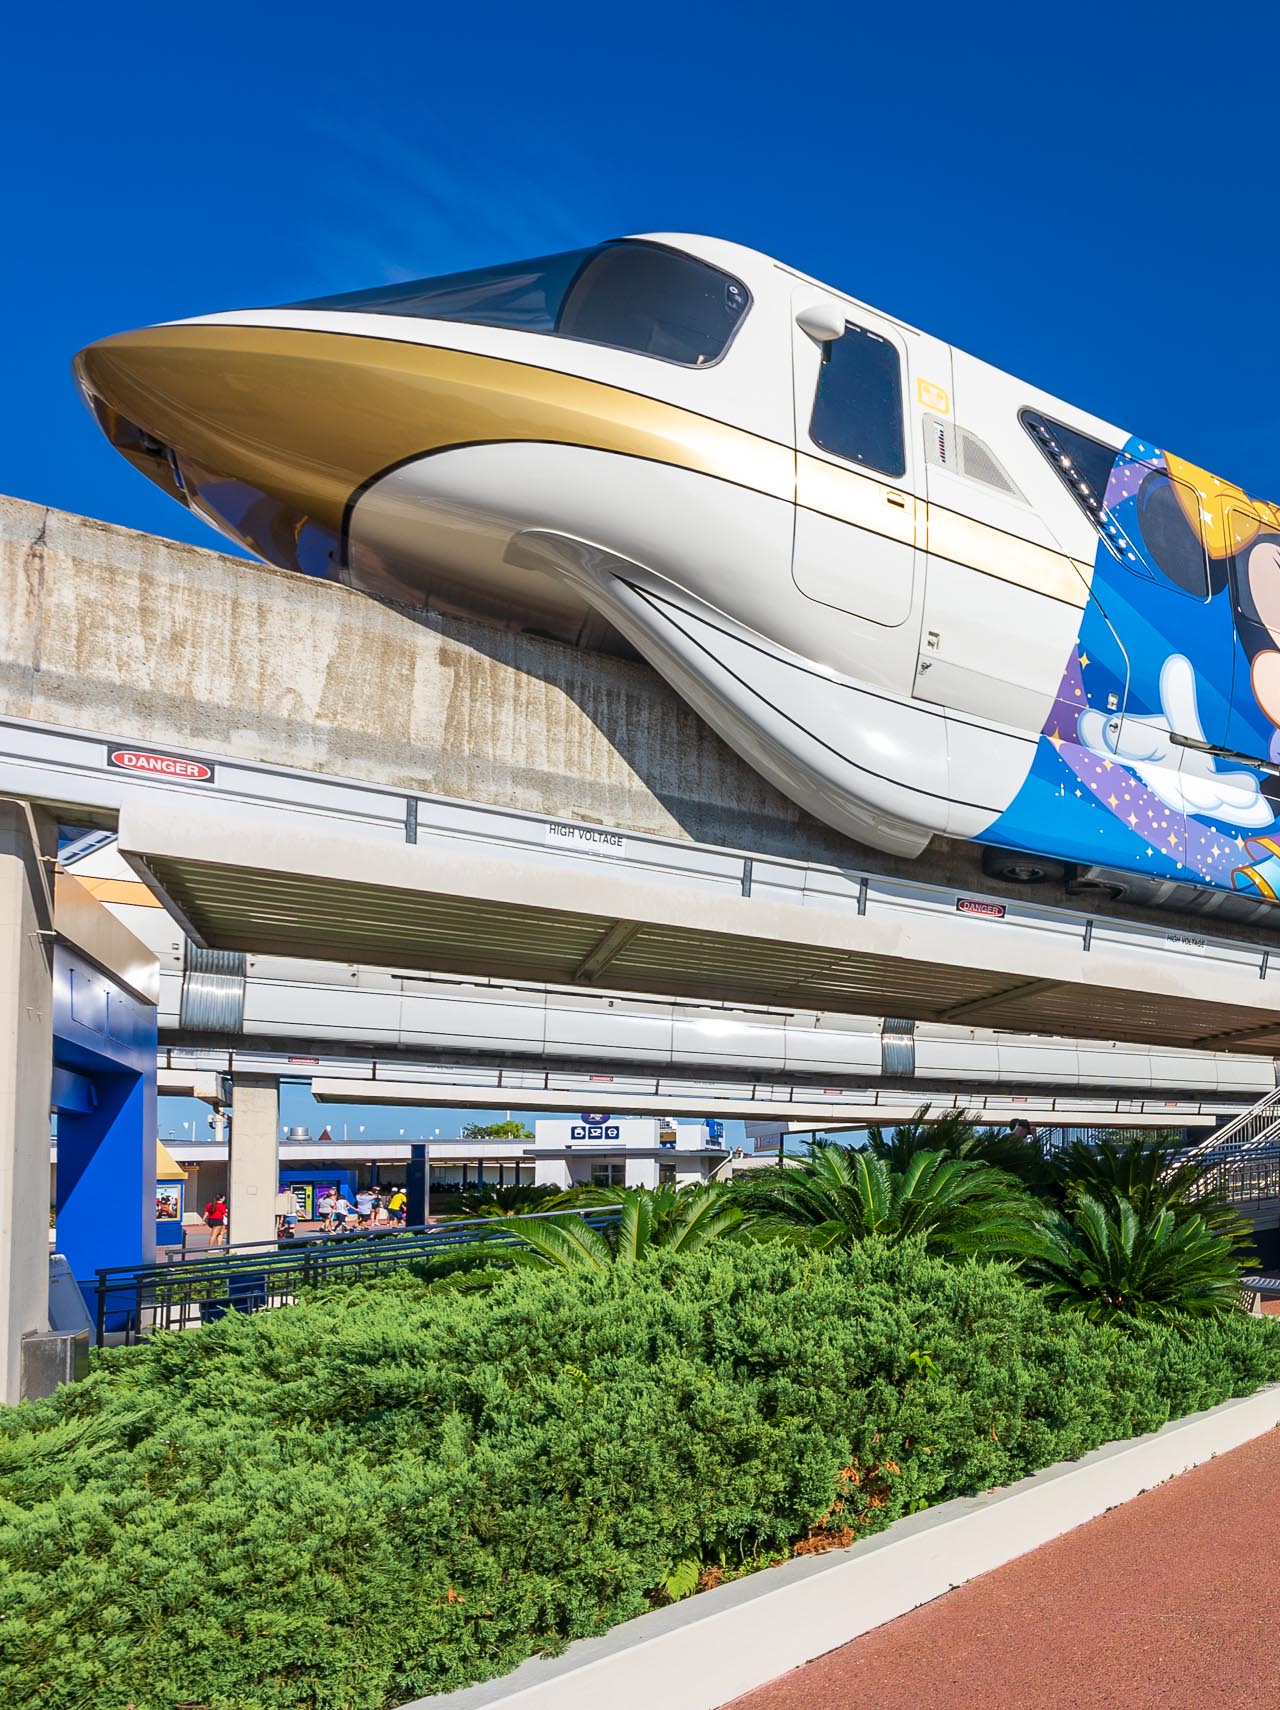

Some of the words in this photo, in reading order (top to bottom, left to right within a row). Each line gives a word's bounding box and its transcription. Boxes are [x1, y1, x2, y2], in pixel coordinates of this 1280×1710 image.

[123, 754, 199, 776] DANGER
[549, 823, 575, 838] HIGH
[578, 829, 623, 847] VOLTAGE
[963, 901, 999, 914] DANGER
